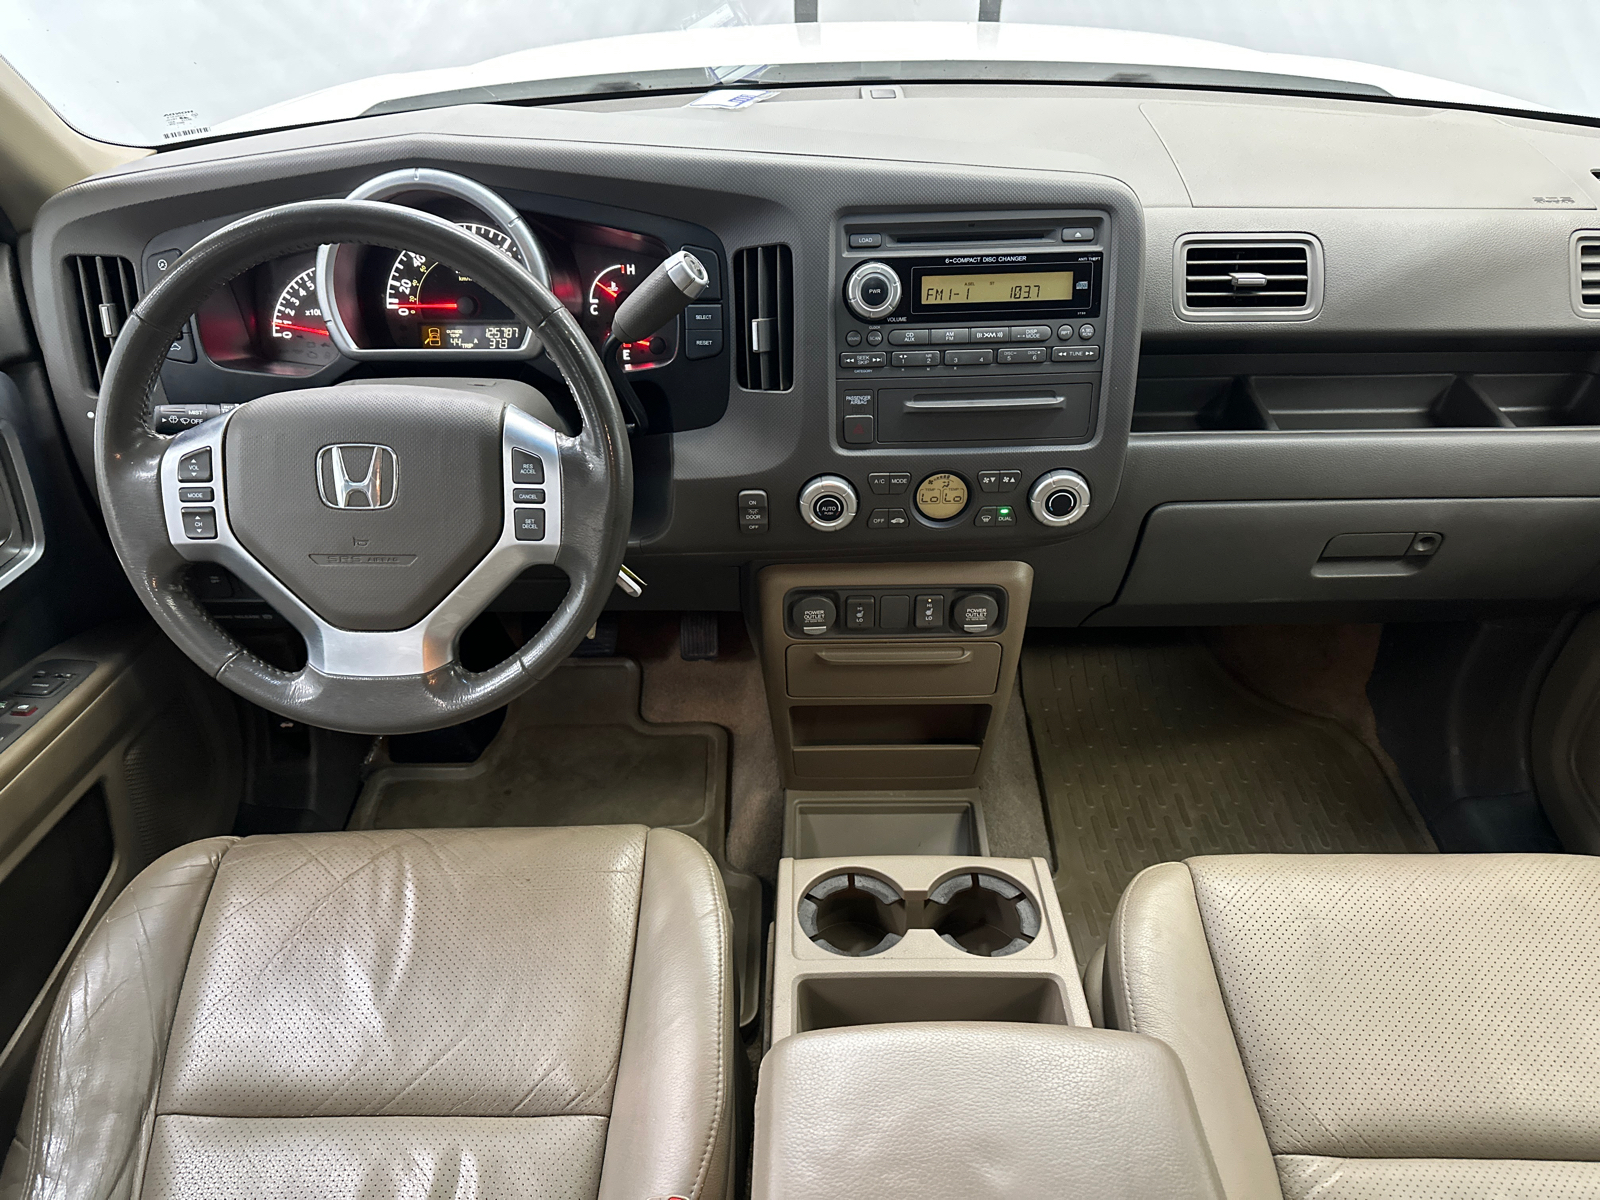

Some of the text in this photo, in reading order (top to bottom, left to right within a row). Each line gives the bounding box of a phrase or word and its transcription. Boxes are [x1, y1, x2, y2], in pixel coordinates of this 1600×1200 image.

[626, 264, 636, 275] H
[305, 280, 315, 291] 5
[398, 279, 412, 295] 20
[298, 287, 307, 297] 4
[1009, 285, 1041, 299] 103.7
[290, 297, 300, 306] 3
[284, 307, 295, 316] 2
[398, 308, 409, 316] 0
[590, 304, 599, 315] C
[282, 331, 292, 339] 0
[485, 327, 519, 339] 125787
[450, 338, 462, 346] 44
[622, 349, 631, 360] E
[327, 555, 400, 564] SRS AIRBAG
